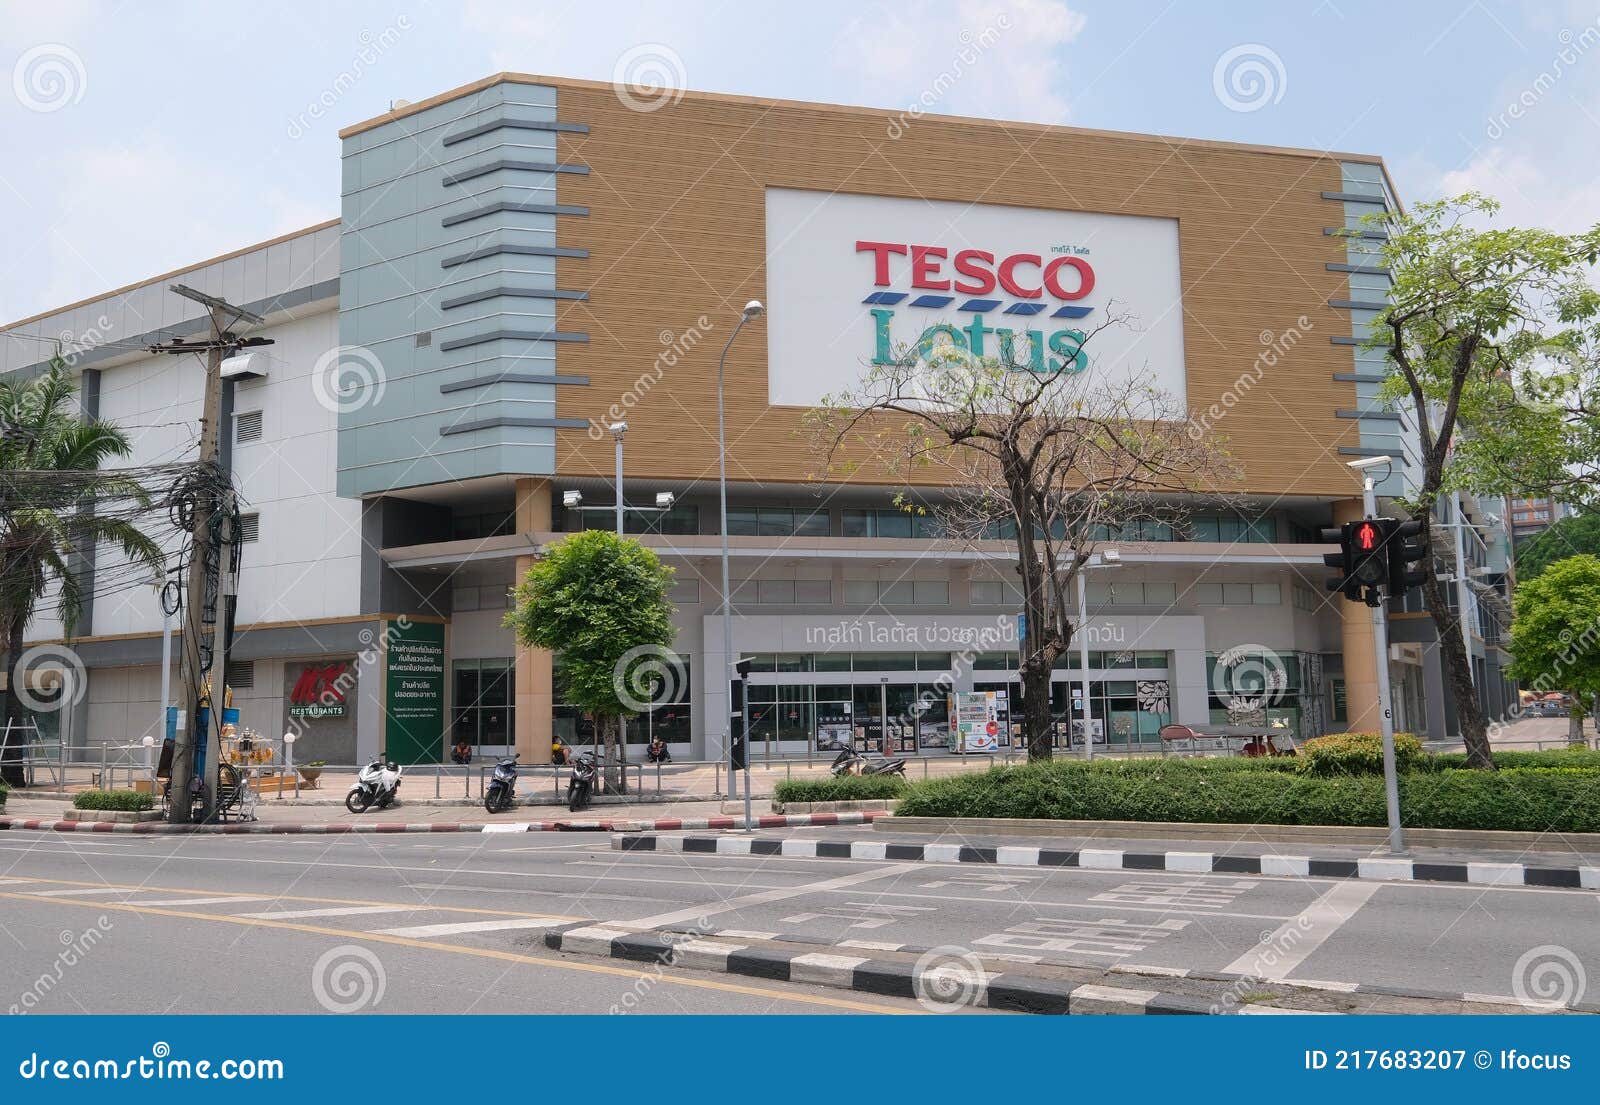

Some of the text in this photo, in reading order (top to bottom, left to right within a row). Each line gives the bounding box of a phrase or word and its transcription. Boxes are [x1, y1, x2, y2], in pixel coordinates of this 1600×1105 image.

[855, 240, 1096, 301] TESCO
[870, 308, 1089, 374] Lotus
[806, 621, 863, 643] เทสโก้
[868, 621, 919, 643] โลตัส
[291, 707, 343, 715] RESTAURANTS
